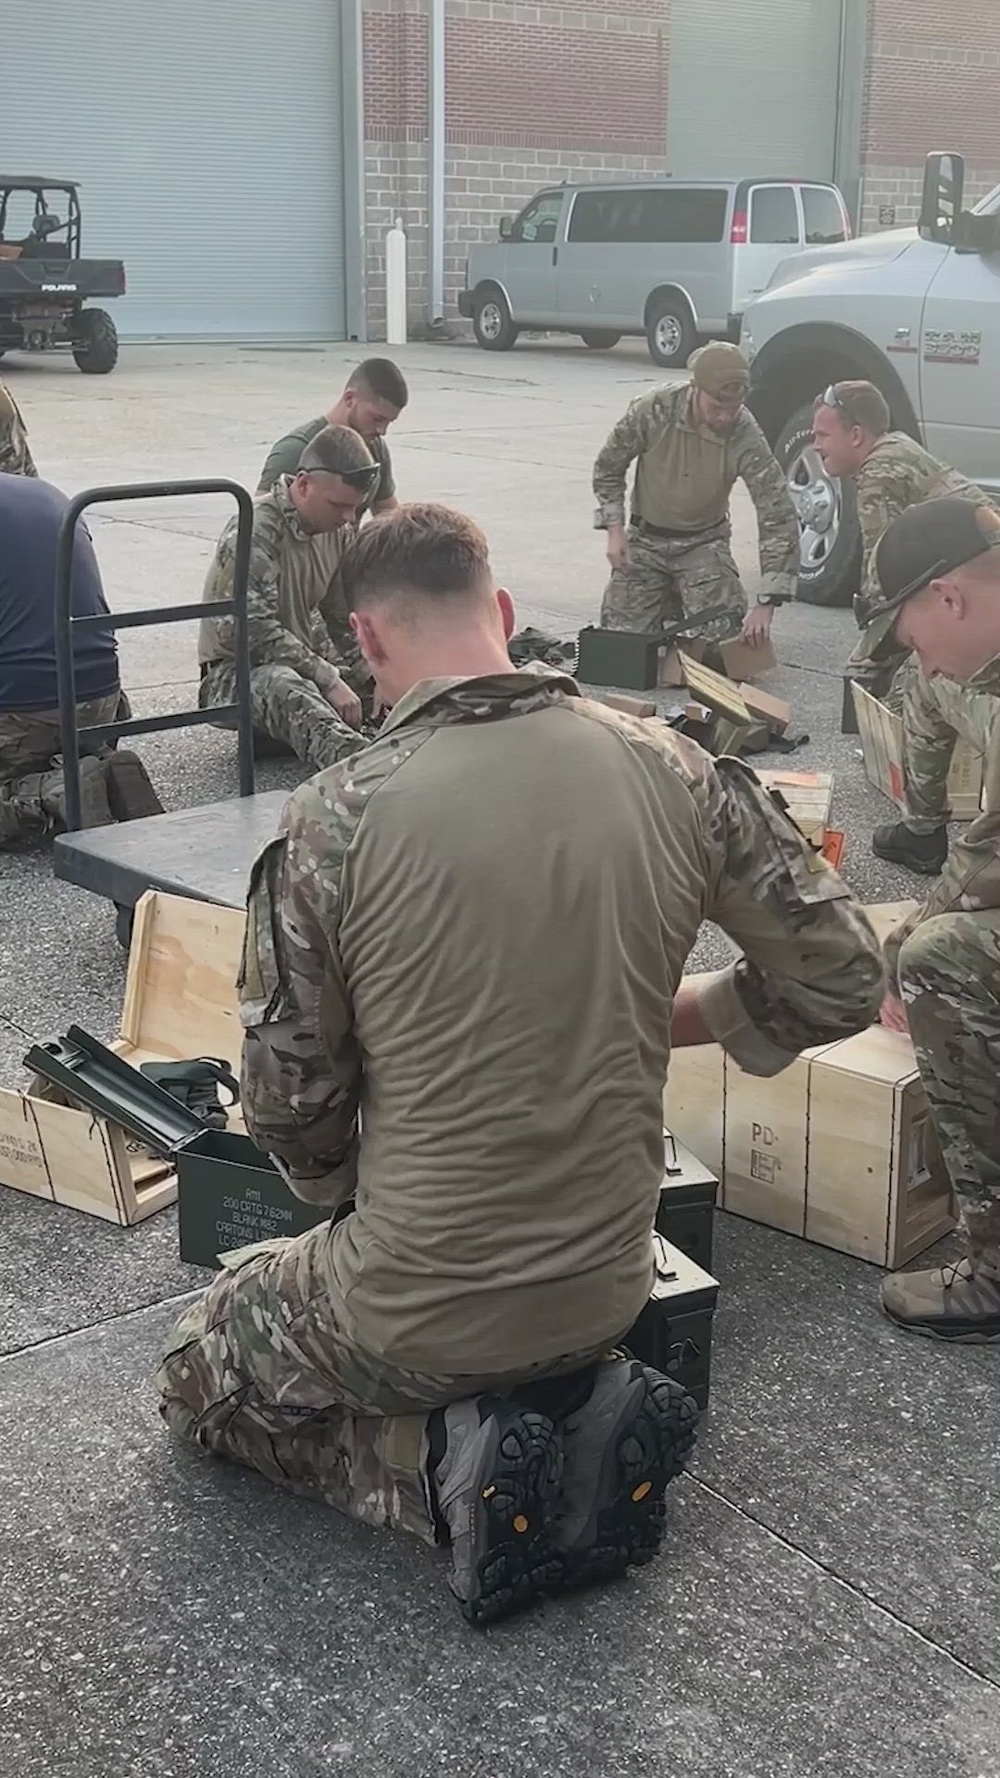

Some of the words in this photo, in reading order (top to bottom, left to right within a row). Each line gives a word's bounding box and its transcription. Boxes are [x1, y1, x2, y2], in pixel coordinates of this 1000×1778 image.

[41, 283, 77, 291] POLARIS
[223, 1196, 239, 1210] 200
[232, 1211, 259, 1227] BLANK
